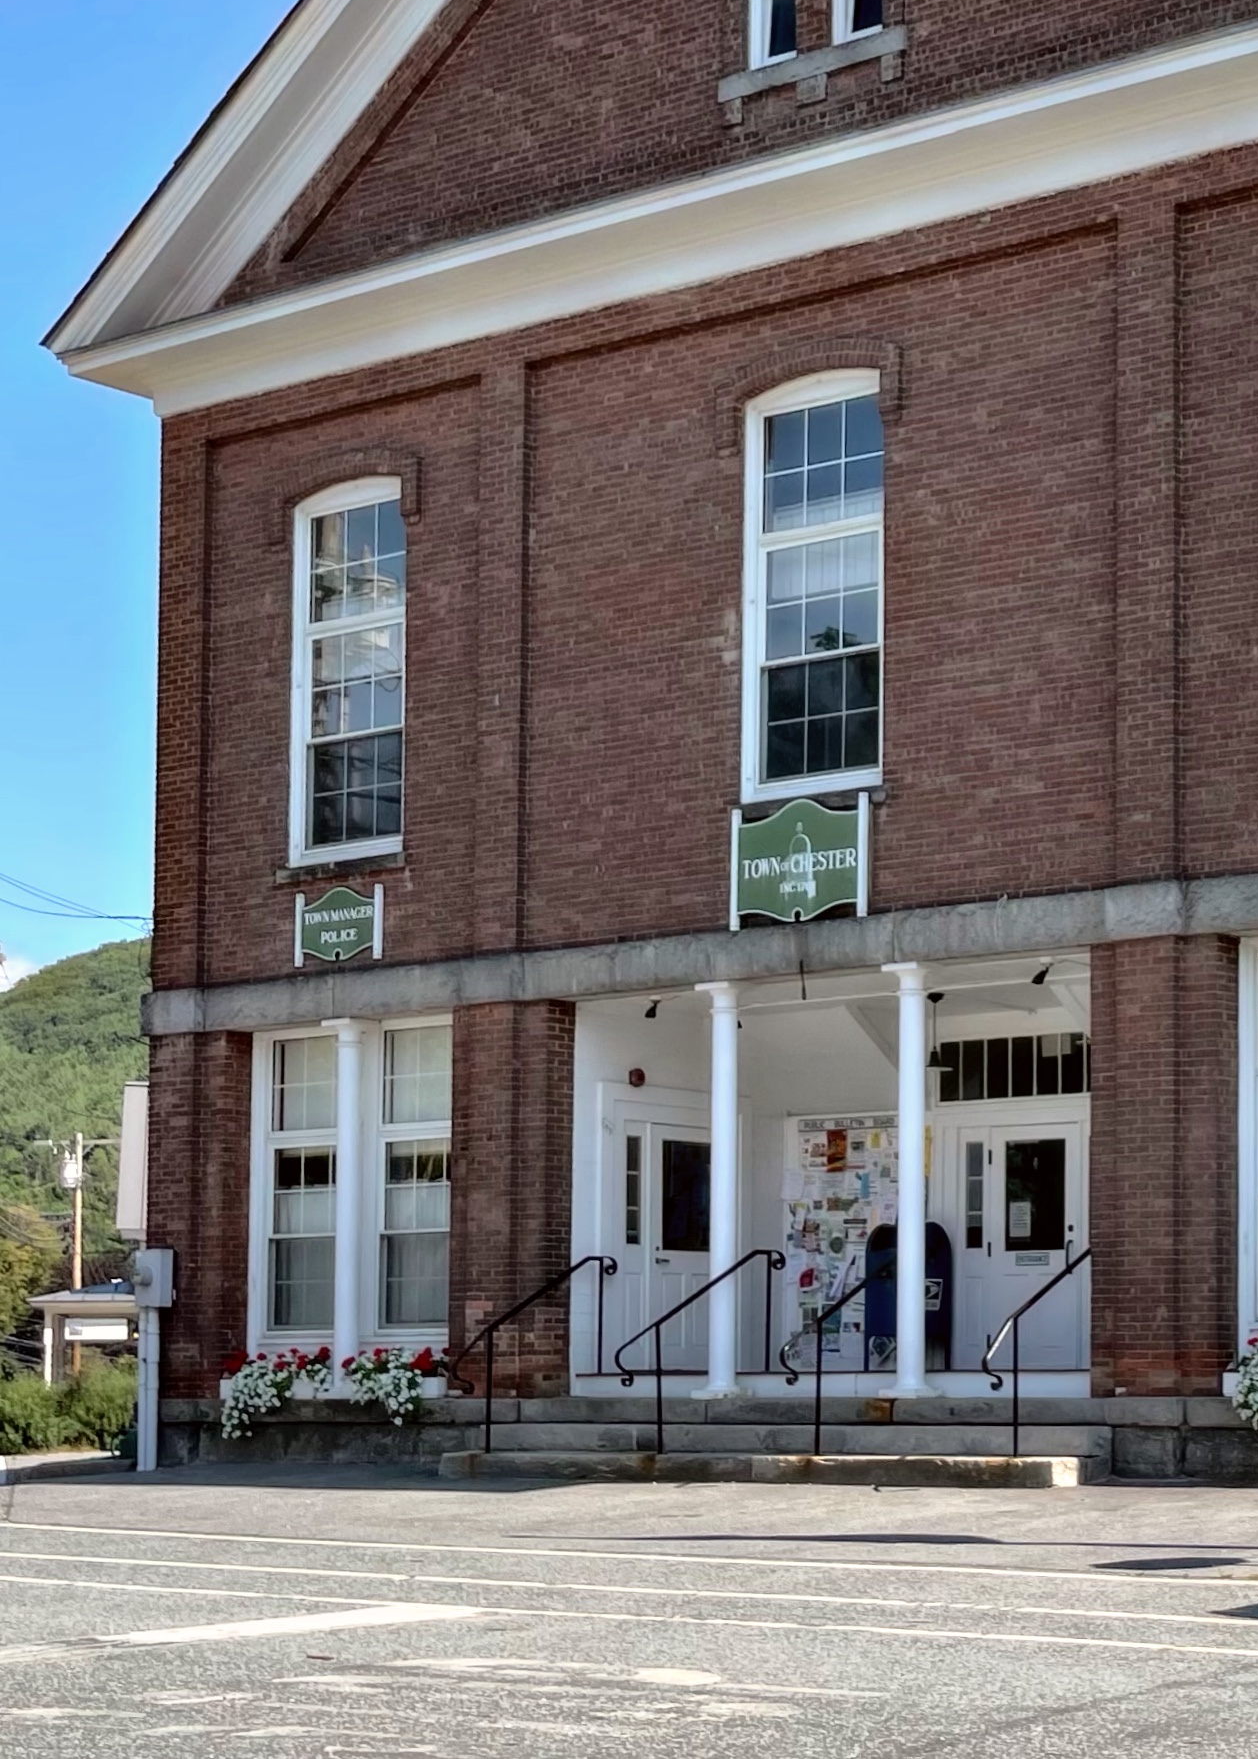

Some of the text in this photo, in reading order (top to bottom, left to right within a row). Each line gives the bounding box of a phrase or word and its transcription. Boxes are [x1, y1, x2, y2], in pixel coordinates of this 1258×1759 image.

[743, 856, 781, 879] TOWN
[790, 847, 856, 873] CHESTER
[304, 905, 374, 925] TOWN MANAGER
[321, 928, 358, 944] POLICE
